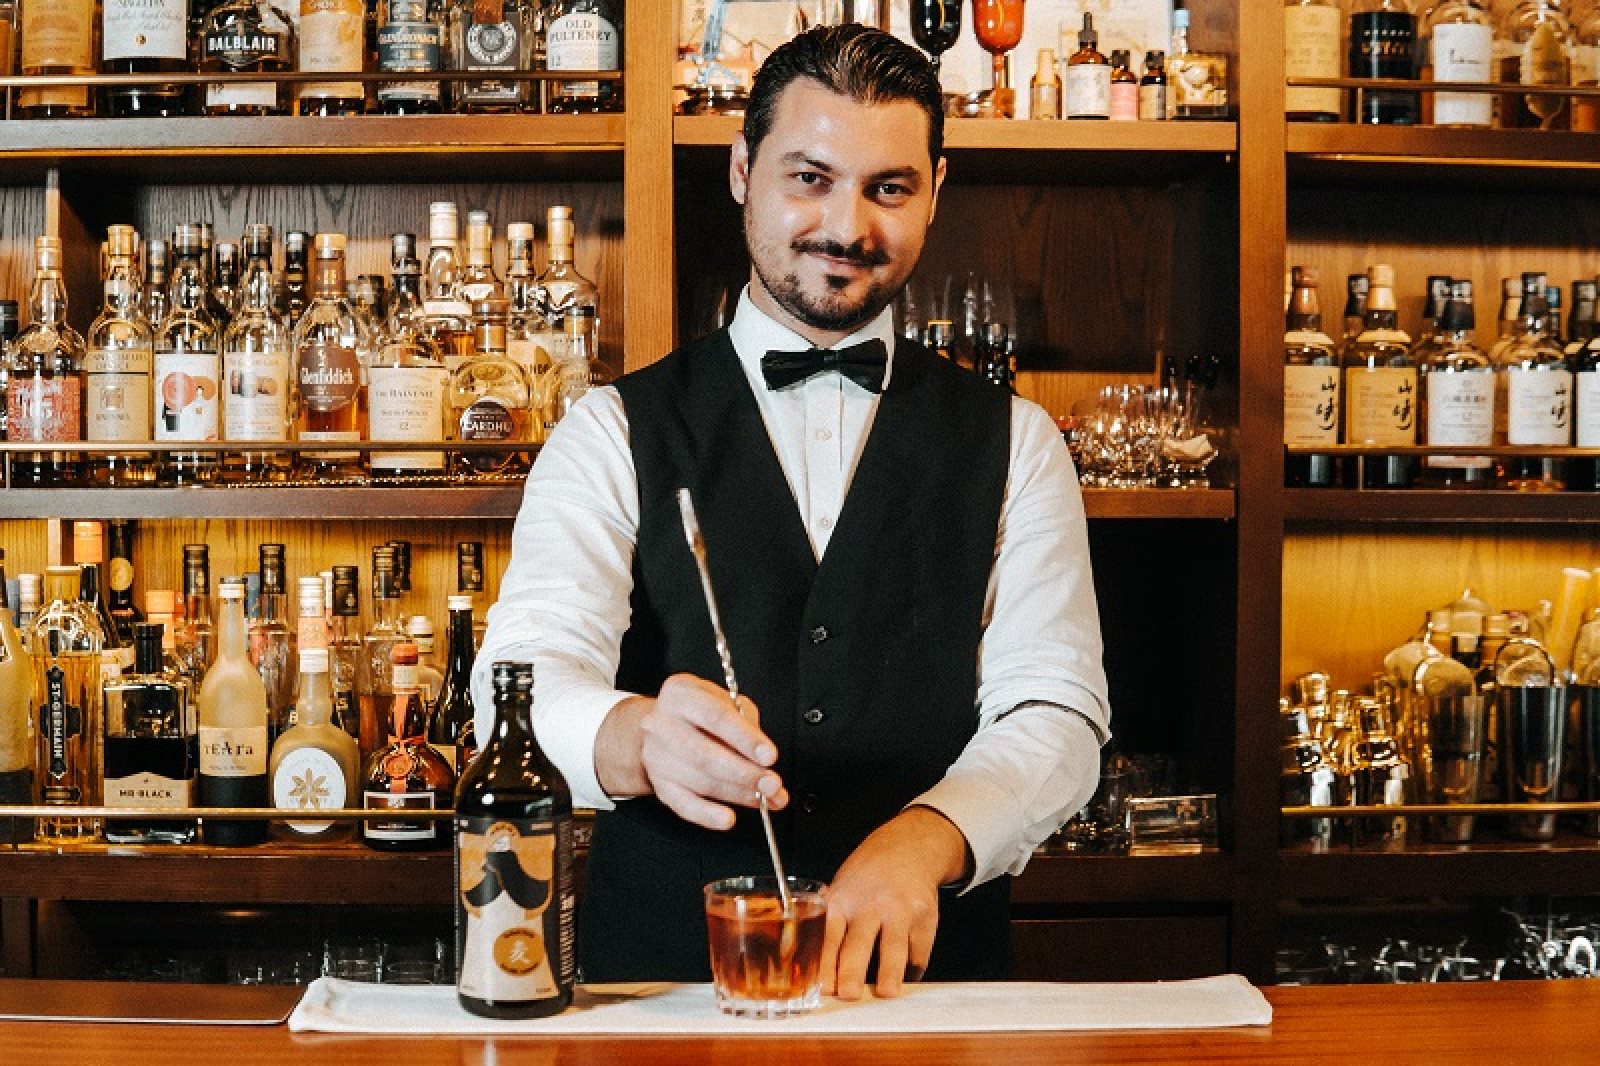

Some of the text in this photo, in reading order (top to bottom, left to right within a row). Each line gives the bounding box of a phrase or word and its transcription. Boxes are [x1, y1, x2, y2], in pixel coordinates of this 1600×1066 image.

[565, 20, 593, 29] OLD
[208, 35, 276, 51] BALBLAIR
[301, 367, 354, 385] Glenfiddich
